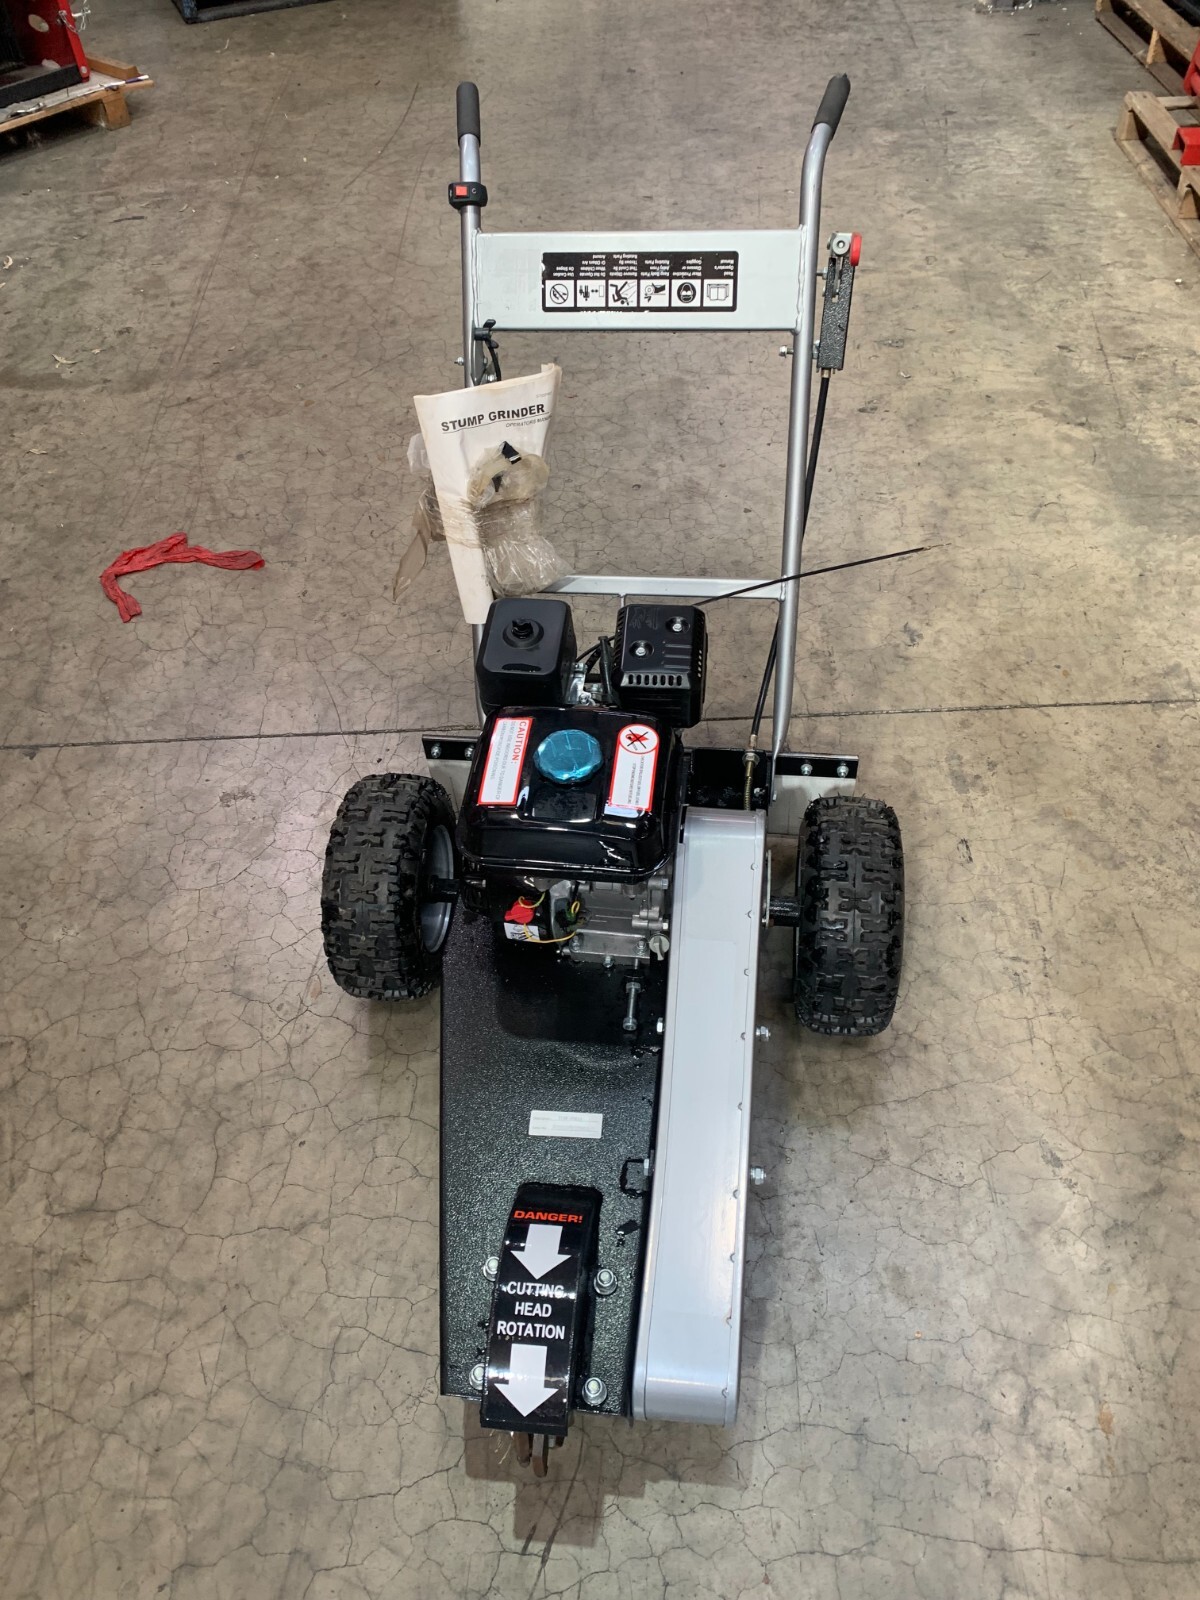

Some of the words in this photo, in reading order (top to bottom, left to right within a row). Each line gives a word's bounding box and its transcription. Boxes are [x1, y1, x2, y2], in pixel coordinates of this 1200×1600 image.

[441, 414, 484, 432] STUMP
[489, 403, 545, 421] GRINDER
[511, 721, 526, 764] CAUTION:
[514, 1210, 583, 1223] DANGER!
[507, 1281, 565, 1298] CUTTING
[515, 1302, 552, 1318] HEAD
[497, 1320, 566, 1340] ROTATION
